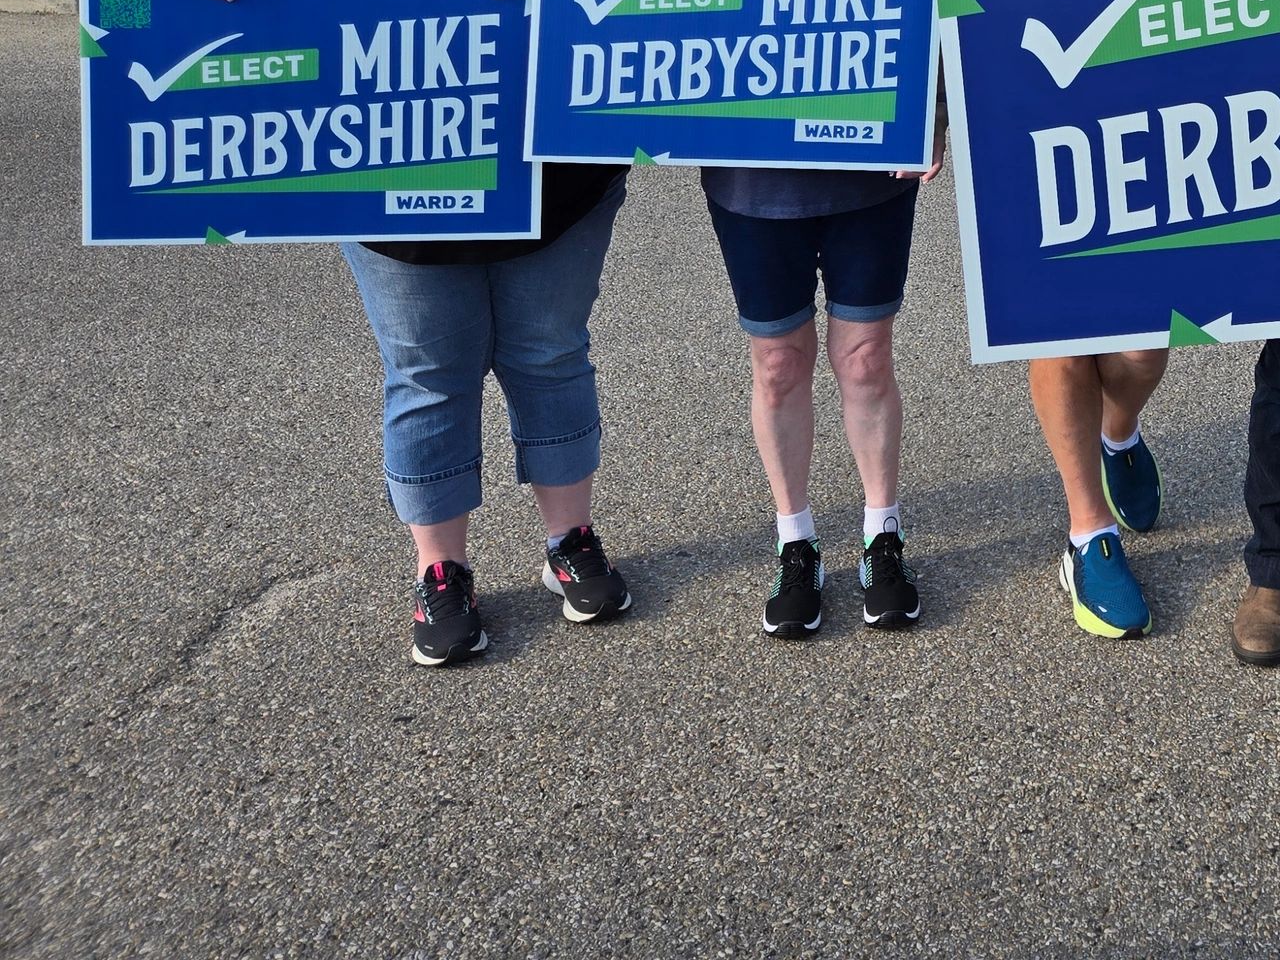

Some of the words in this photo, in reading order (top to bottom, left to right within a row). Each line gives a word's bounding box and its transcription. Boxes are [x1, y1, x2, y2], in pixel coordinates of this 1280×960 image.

[201, 54, 304, 85] ELECT
[339, 13, 500, 96] MIKE
[568, 28, 901, 107] DERBYSHIRE
[128, 93, 499, 188] DERBYSHIRE
[804, 124, 858, 139] WARD
[861, 126, 874, 140] 2
[396, 195, 457, 210] WARD
[461, 195, 474, 209] 2
